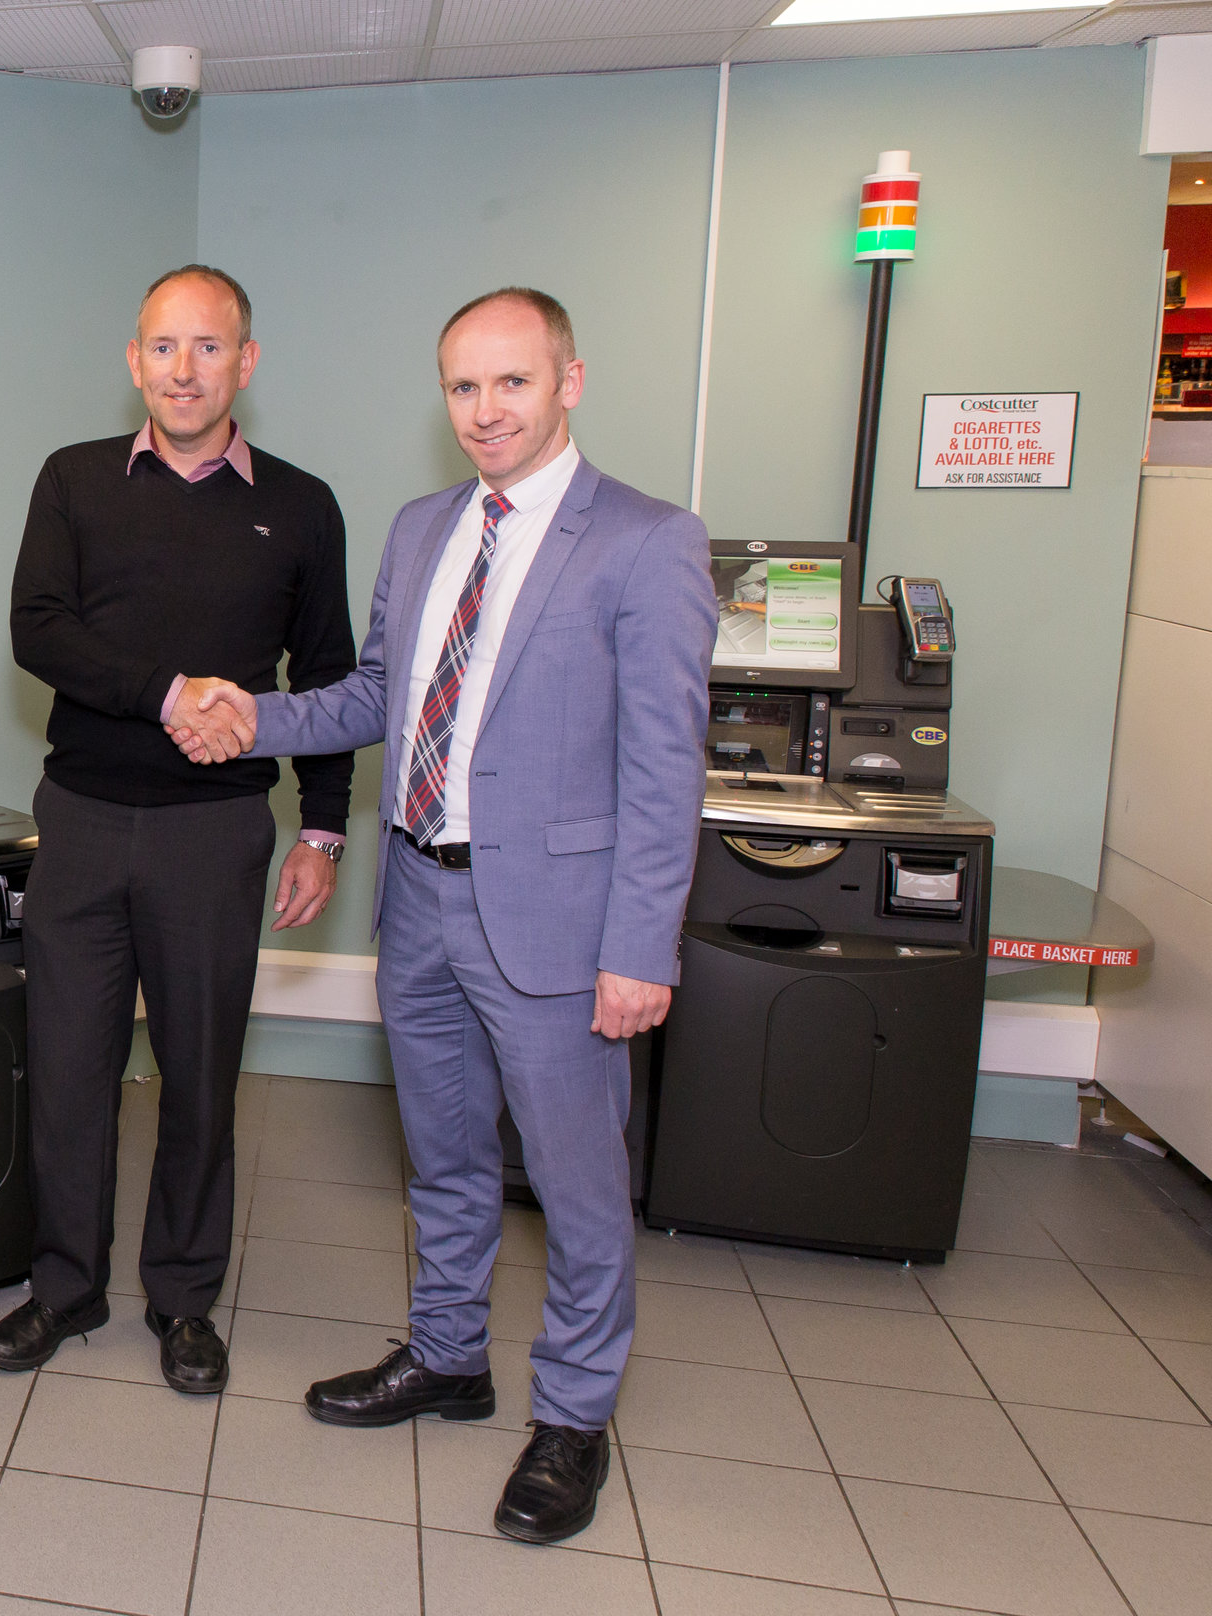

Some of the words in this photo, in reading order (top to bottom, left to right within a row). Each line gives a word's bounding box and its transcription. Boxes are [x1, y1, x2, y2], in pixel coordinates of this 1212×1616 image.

[960, 399, 1039, 411] Costcutter
[954, 421, 1041, 434] CIGARETTES
[950, 438, 958, 450] &
[964, 437, 1012, 450] LOTTO,
[1017, 438, 1042, 449] etc.
[935, 452, 1014, 465] AVAILABLE
[1018, 452, 1055, 464] HERE
[945, 473, 963, 483] ASK
[966, 473, 984, 483] FOR
[986, 473, 1041, 483] ASSISTANCE
[915, 730, 944, 740] CBE
[994, 941, 1036, 958] PLACE
[1042, 946, 1095, 963] BASKET
[1102, 951, 1132, 965] HERE
